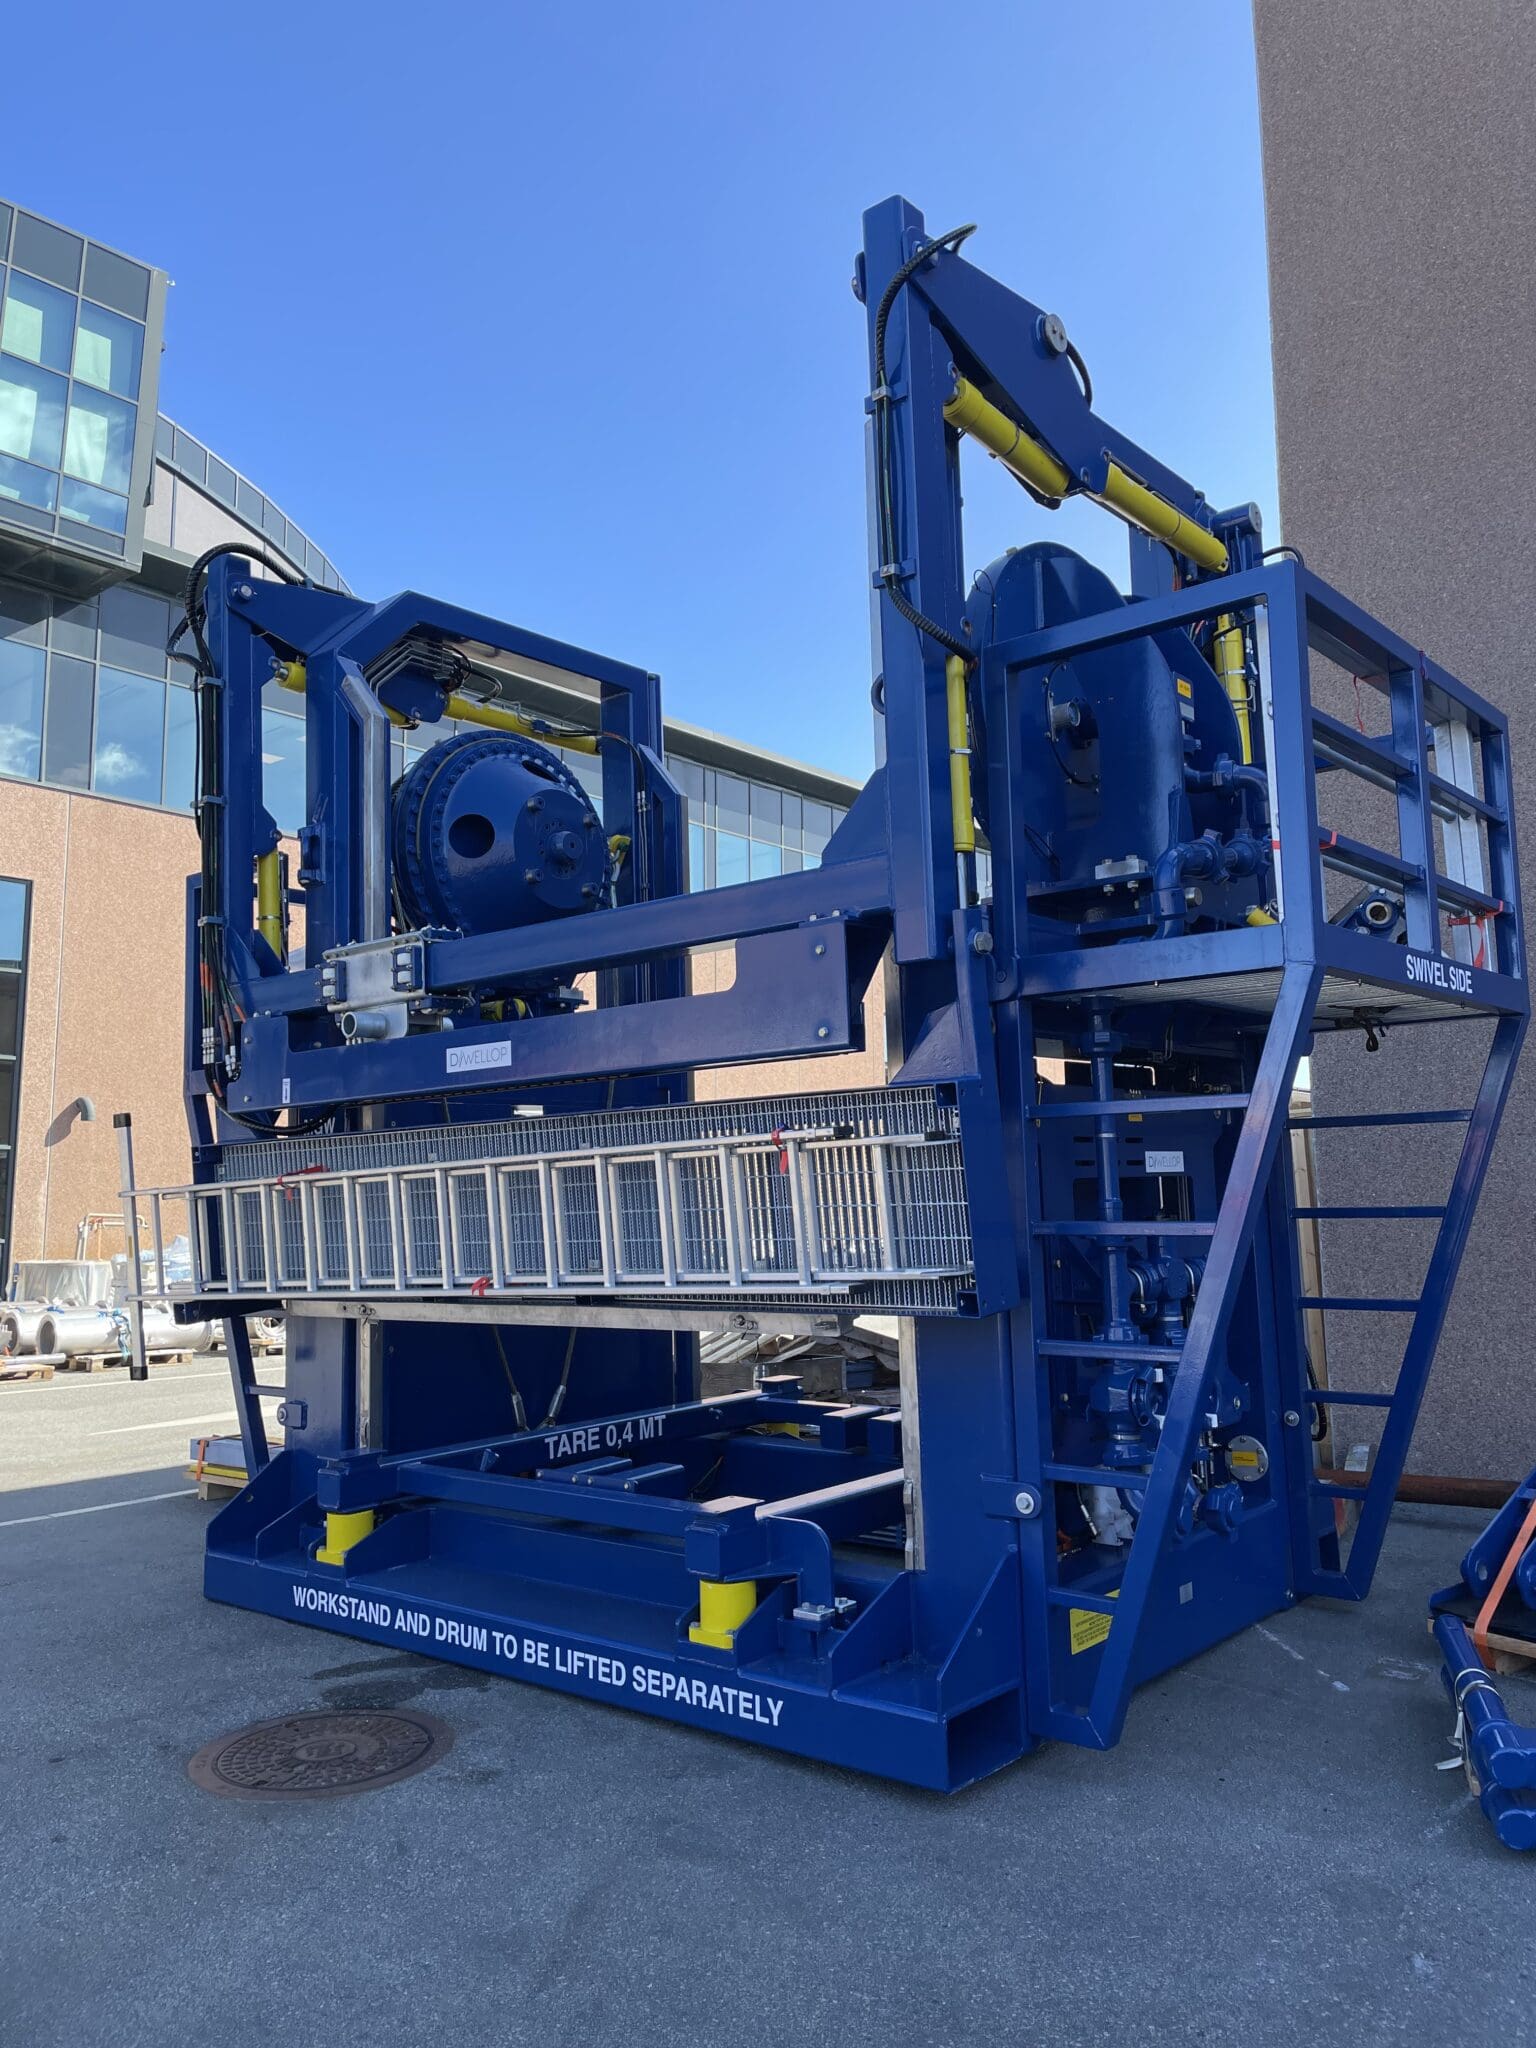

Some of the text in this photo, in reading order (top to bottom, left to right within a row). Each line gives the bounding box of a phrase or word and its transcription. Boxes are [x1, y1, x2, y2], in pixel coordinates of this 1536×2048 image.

[1406, 954, 1473, 993] SWIVEL SIDE
[544, 1415, 666, 1460] TARE 0,4 MT
[293, 1585, 784, 1727] WORKSTAND AND DRUM TO BE LIFTED SEPARATELY
